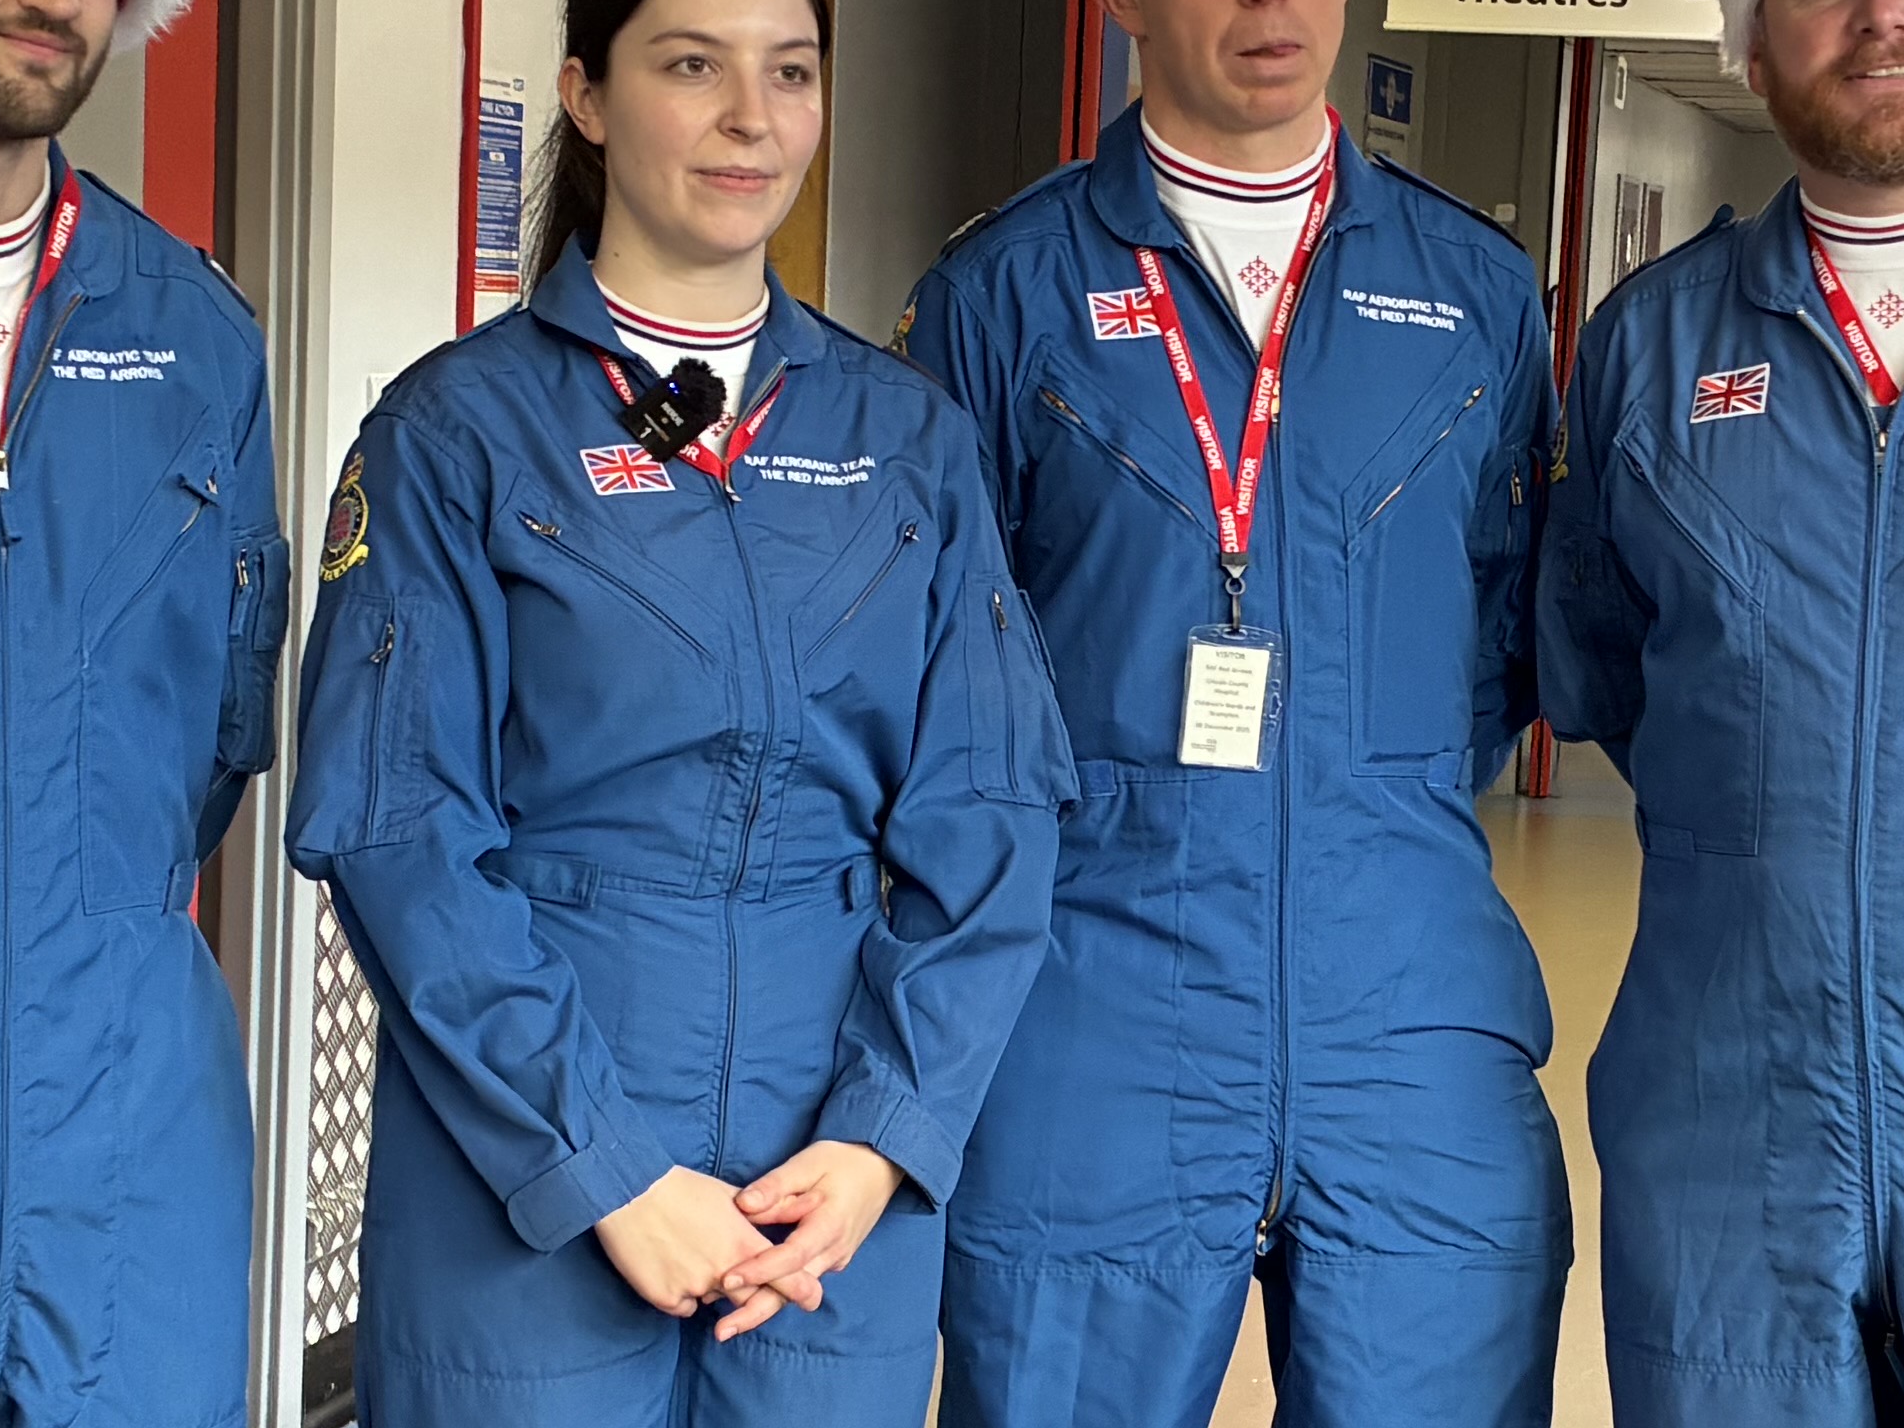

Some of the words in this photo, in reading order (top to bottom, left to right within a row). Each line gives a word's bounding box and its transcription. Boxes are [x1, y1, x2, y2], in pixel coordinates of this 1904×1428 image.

[49, 202, 77, 259] VISITOR
[1301, 200, 1323, 253] VISITOR
[1139, 247, 1165, 297] ISITOR
[1271, 281, 1296, 336] VISITOR
[1356, 306, 1379, 321] THE
[1381, 310, 1406, 323] RED
[1434, 302, 1464, 320] TEAM
[51, 365, 77, 380] THE
[80, 366, 106, 380] RED
[1164, 327, 1193, 384] VISITOR
[1845, 320, 1879, 374] VISITOR
[1252, 367, 1275, 423] VISITOR
[1194, 415, 1223, 471] VISITOR
[759, 469, 785, 481] THE
[787, 471, 812, 484] RED
[1236, 457, 1258, 516] VISITOR
[1219, 506, 1240, 553] VISITO
